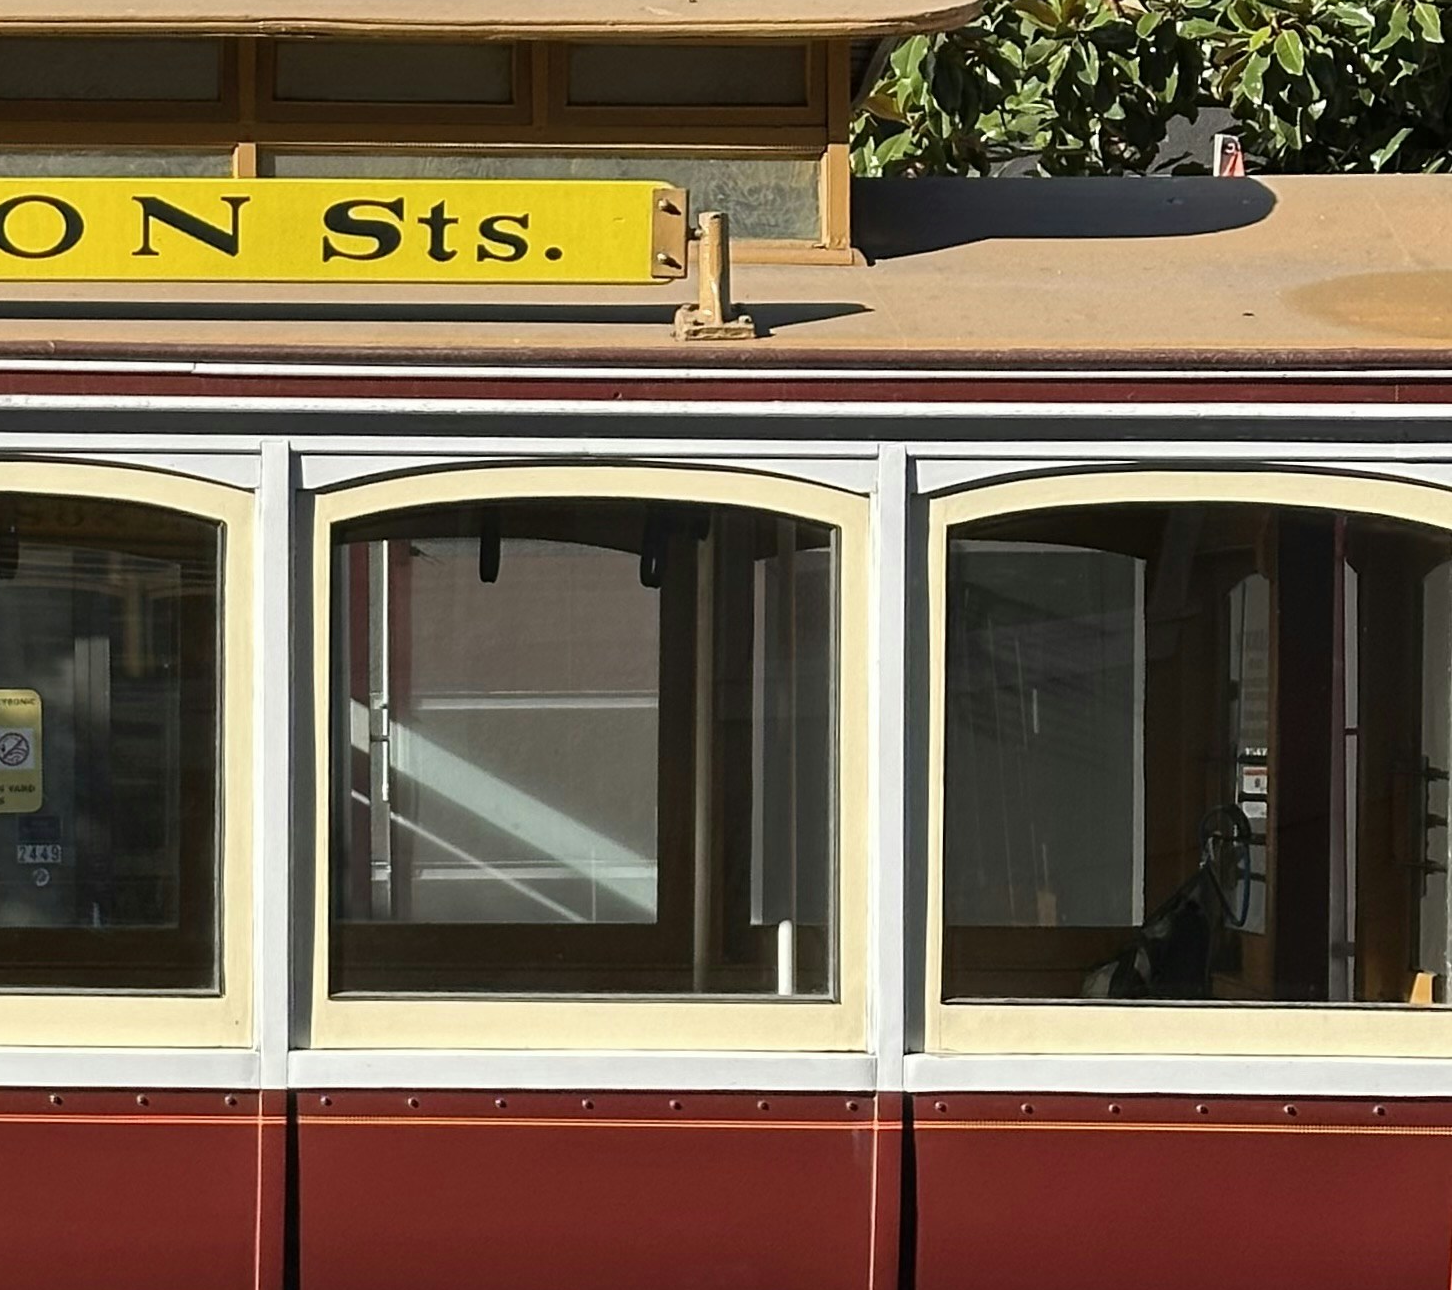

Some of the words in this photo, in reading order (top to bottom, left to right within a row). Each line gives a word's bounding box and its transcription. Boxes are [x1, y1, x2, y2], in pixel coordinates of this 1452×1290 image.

[322, 196, 564, 262] Sts.
[8, 785, 36, 793] YARD
[19, 846, 60, 860] 2449
